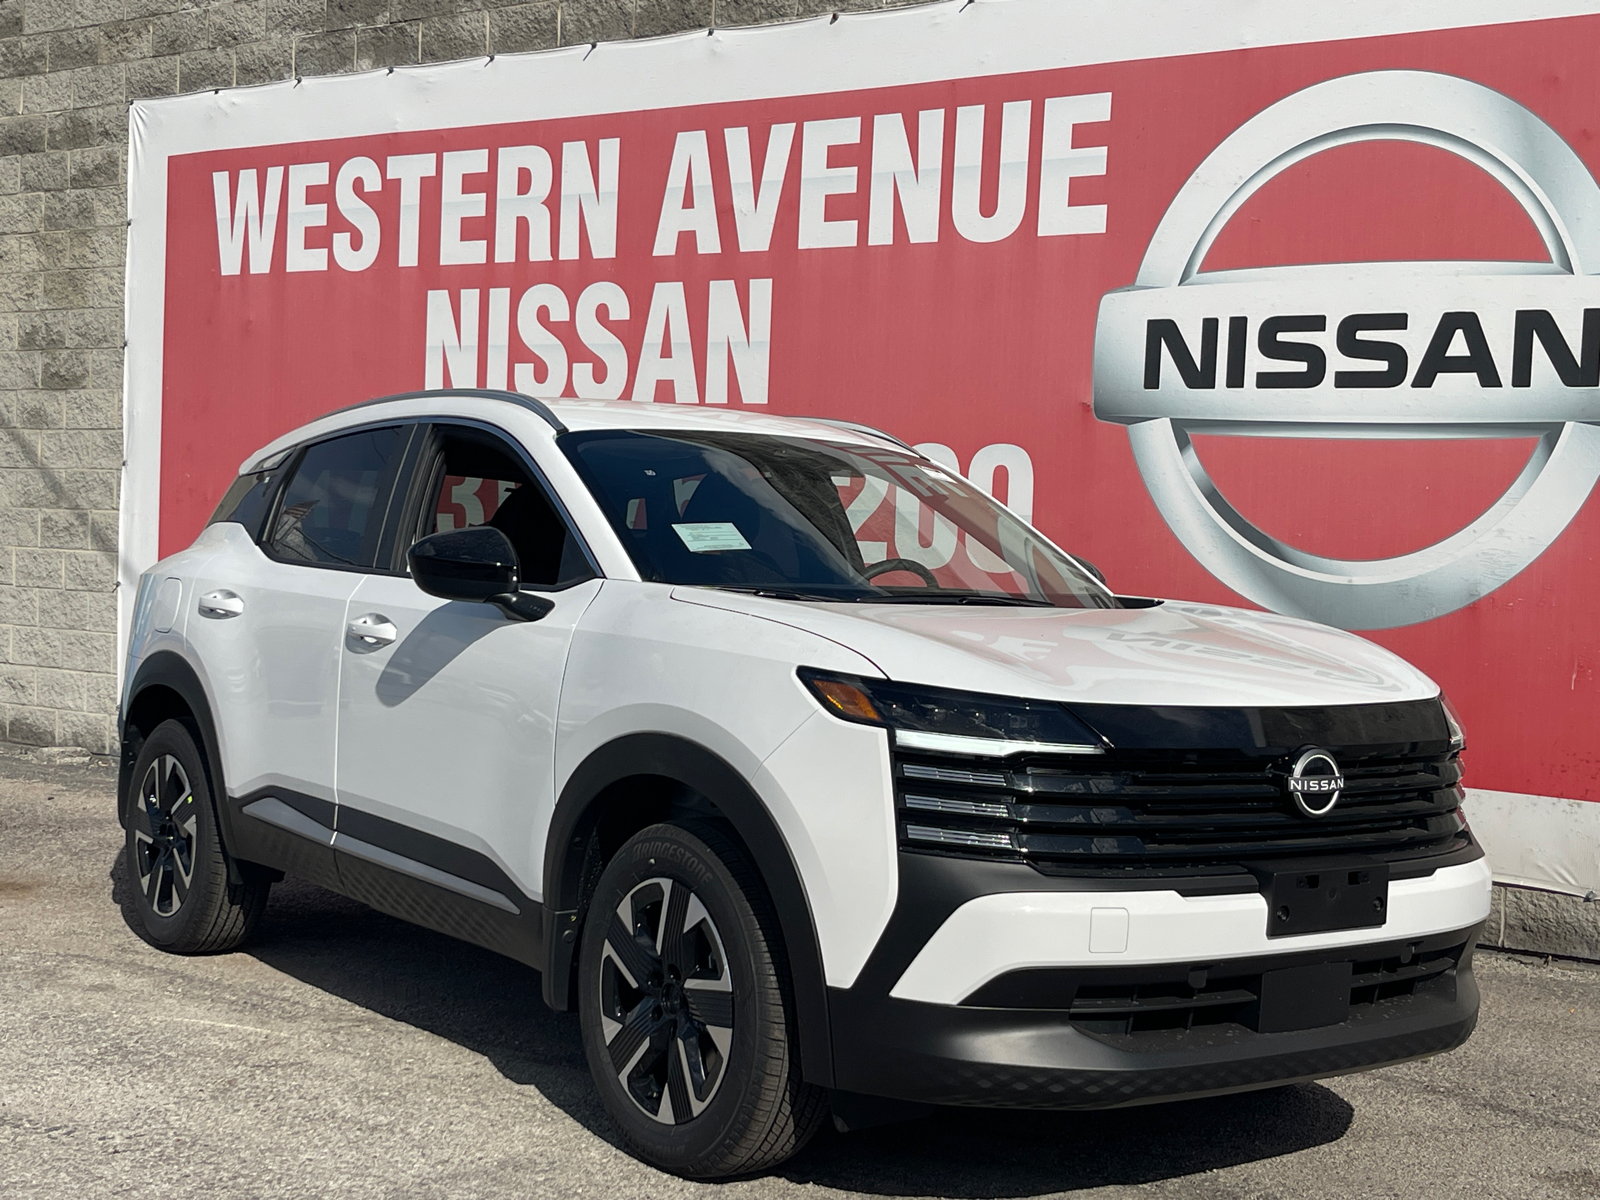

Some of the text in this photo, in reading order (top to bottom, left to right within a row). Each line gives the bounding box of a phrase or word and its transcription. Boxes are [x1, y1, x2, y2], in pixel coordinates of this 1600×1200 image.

[212, 92, 1112, 276] WESTERN AVENUE
[425, 280, 773, 405] NISSAN
[1143, 308, 1600, 390] NISSAN
[1290, 777, 1345, 791] NISSAN
[632, 841, 713, 884] BRIDGESTONE
